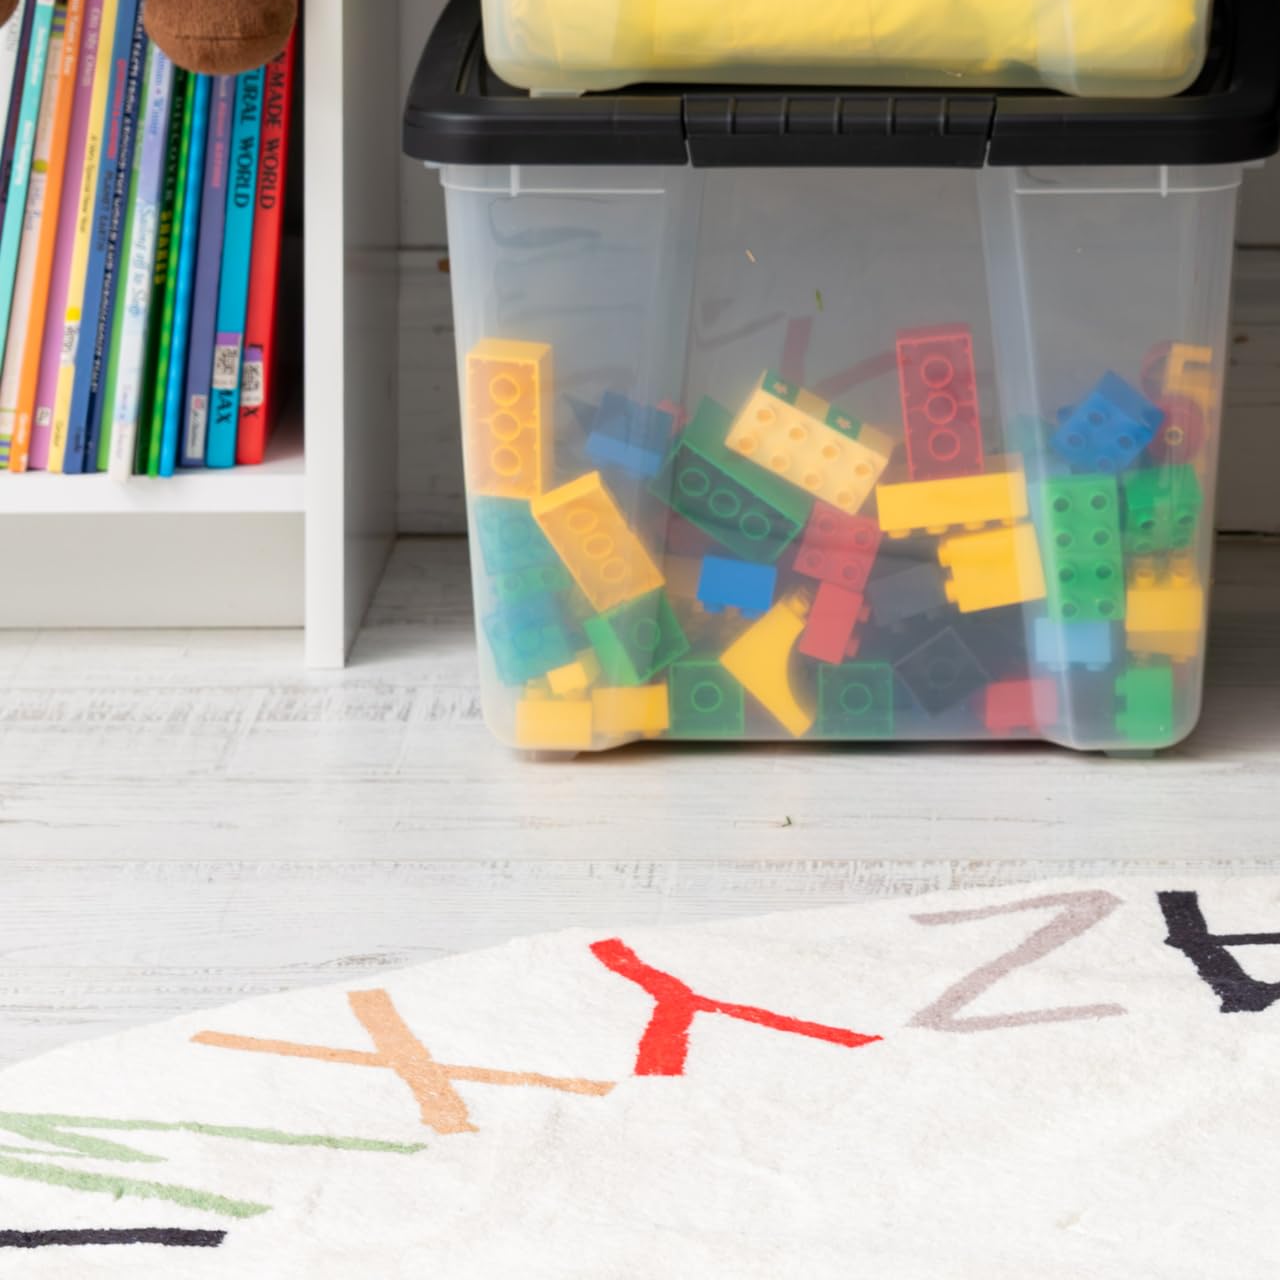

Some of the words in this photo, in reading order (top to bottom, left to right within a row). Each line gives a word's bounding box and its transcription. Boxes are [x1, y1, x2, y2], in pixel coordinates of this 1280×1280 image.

[239, 69, 260, 126] URAL
[266, 50, 286, 129] N-MADE
[117, 116, 132, 169] AROUND
[165, 95, 182, 201] DISCOVER
[233, 134, 254, 208] WORLD
[258, 137, 279, 210] WORLD
[114, 171, 124, 194] THE
[108, 196, 121, 241] WORLD
[104, 243, 115, 270] AND
[192, 989, 614, 1134] X
[589, 939, 883, 1076] Y
[913, 890, 1122, 1030] Z
